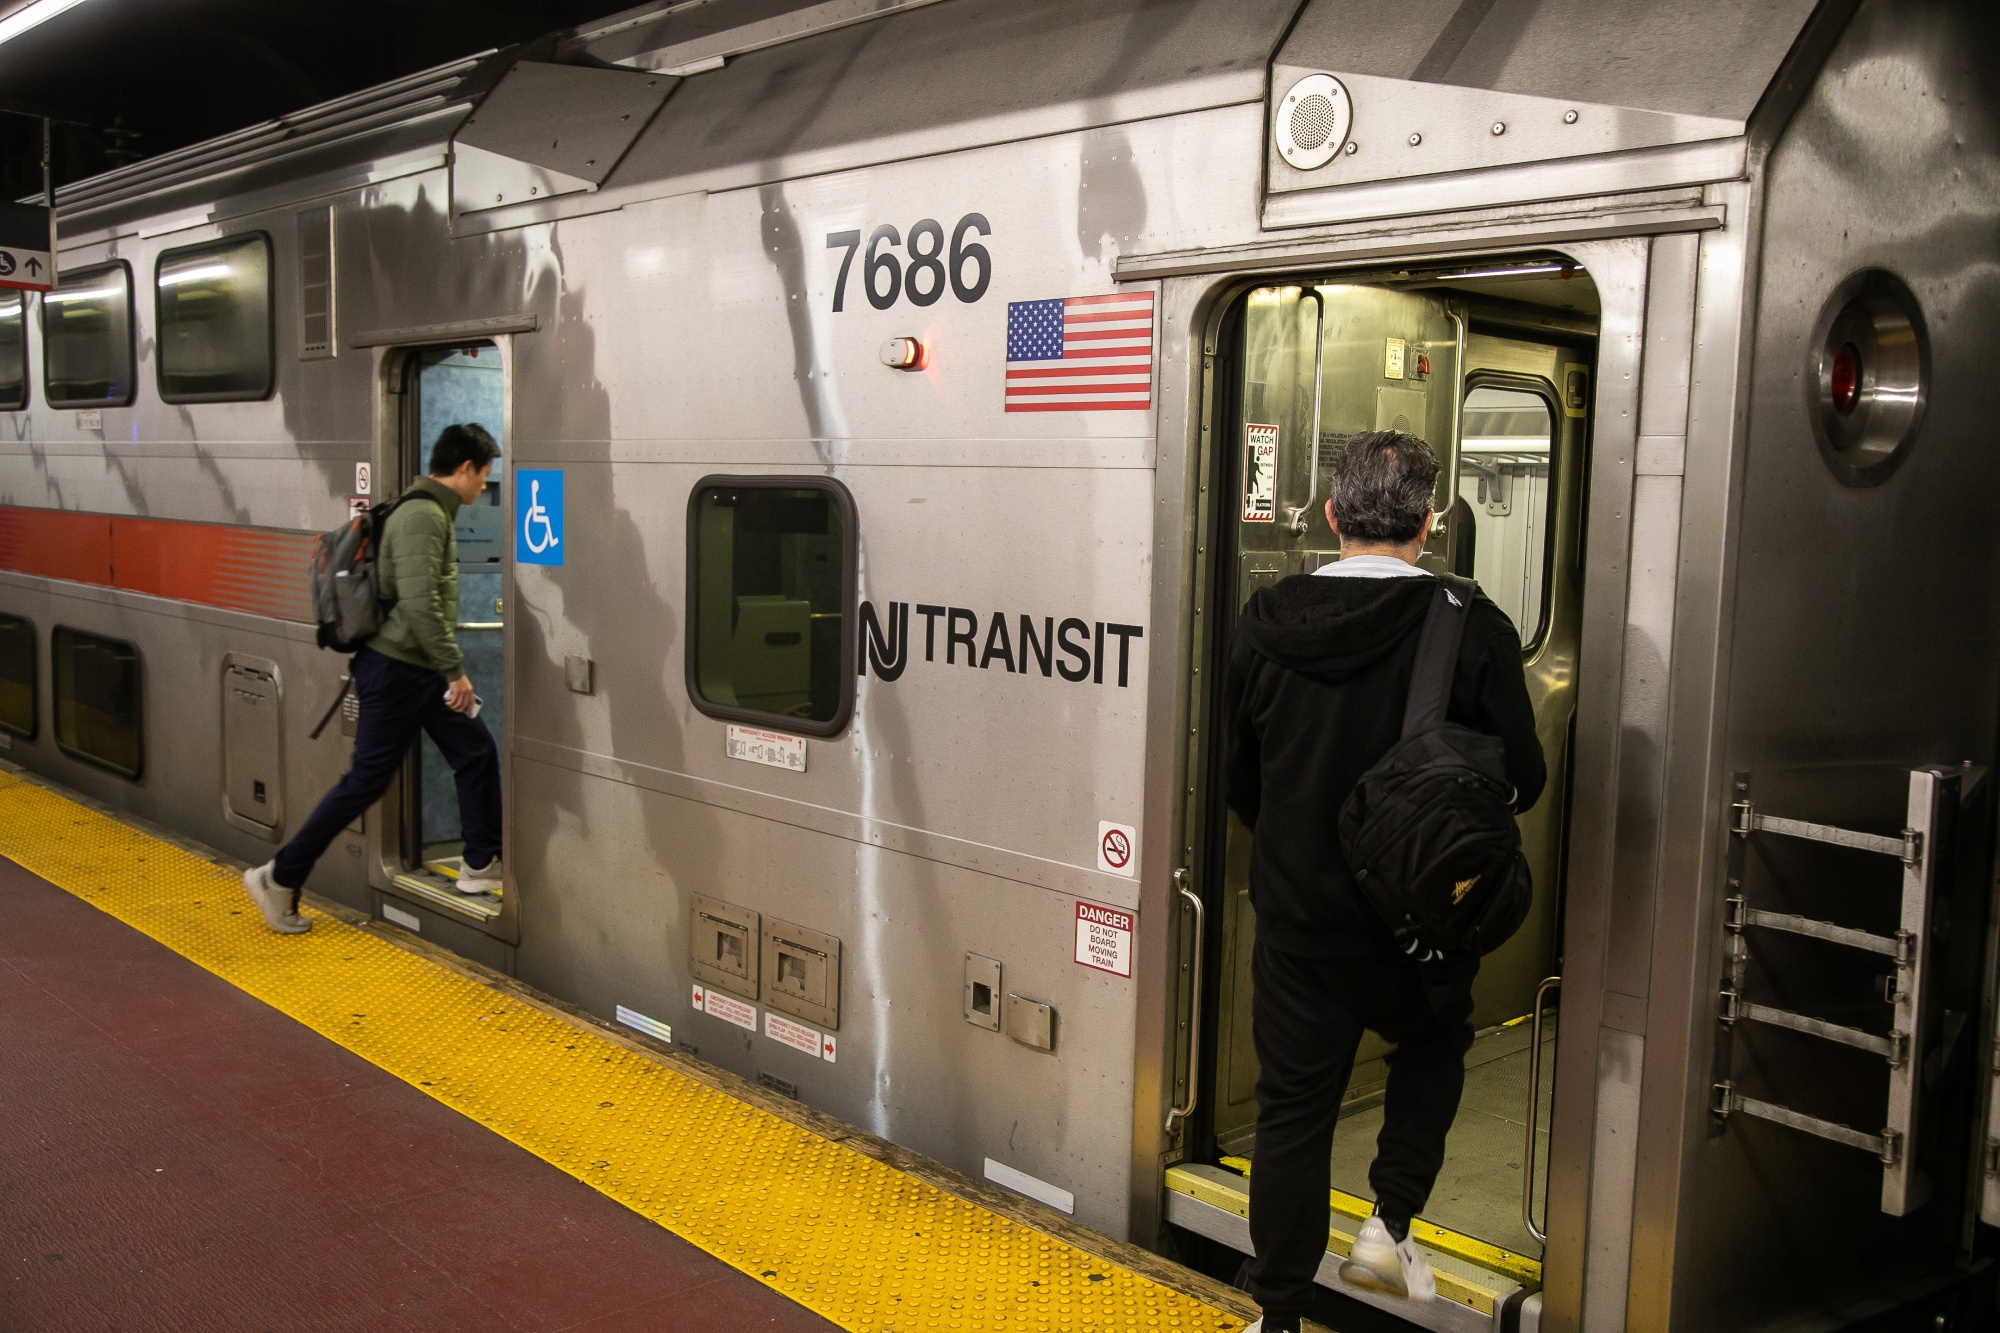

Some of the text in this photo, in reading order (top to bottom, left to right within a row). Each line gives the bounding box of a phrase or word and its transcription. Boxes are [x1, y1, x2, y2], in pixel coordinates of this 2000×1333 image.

[826, 212, 992, 313] 7686
[1250, 435, 1274, 444] WATCH
[1258, 446, 1274, 456] GAP
[857, 600, 1143, 688] NJ TRANSIT
[739, 728, 761, 736] EMERGENCY
[777, 734, 793, 742] WINDOW
[1079, 905, 1129, 930] DANGER
[1090, 925, 1118, 939] DO NOT
[1090, 935, 1116, 948] BOARD
[1088, 944, 1117, 959] MOVING
[1092, 955, 1113, 968] TRAIN
